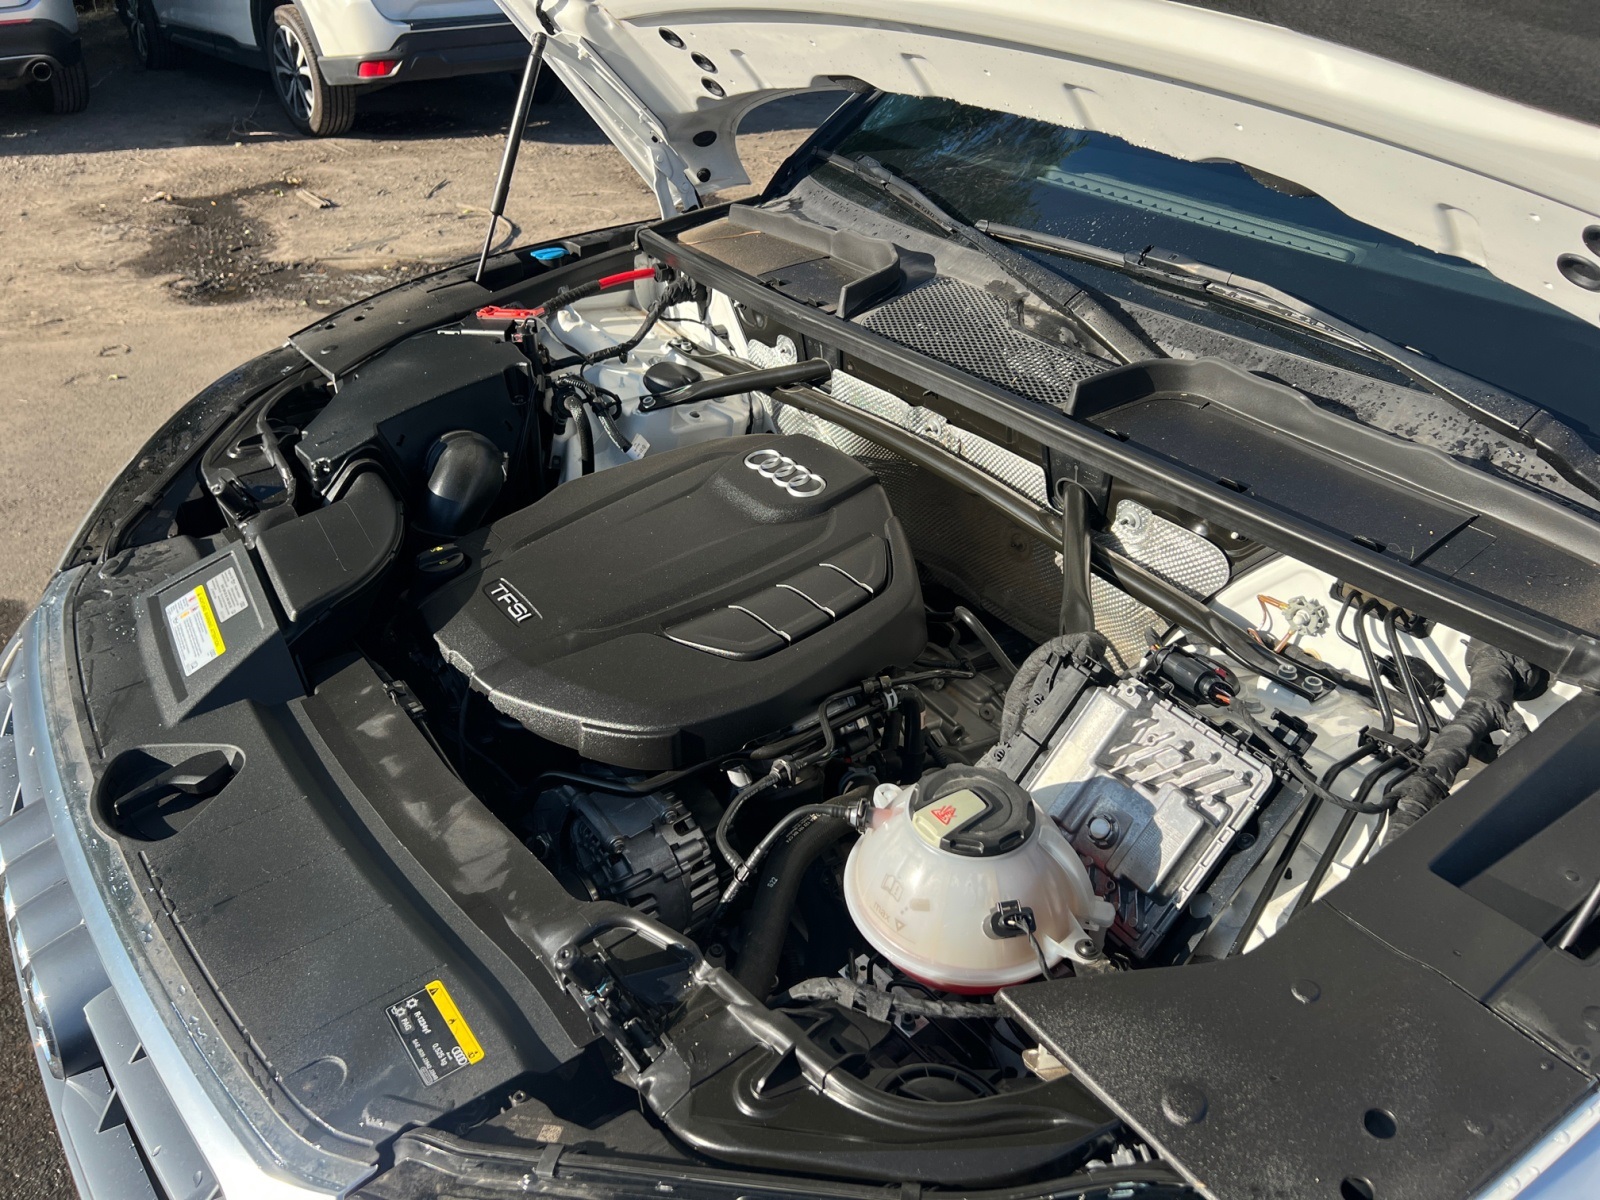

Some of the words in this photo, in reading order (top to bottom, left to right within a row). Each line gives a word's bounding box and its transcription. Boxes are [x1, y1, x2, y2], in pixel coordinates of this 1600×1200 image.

[491, 582, 532, 622] TFSI
[874, 902, 891, 923] max
[401, 1017, 412, 1031] PAG
[414, 1010, 432, 1035] R-1234yf
[440, 1057, 447, 1067] kg
